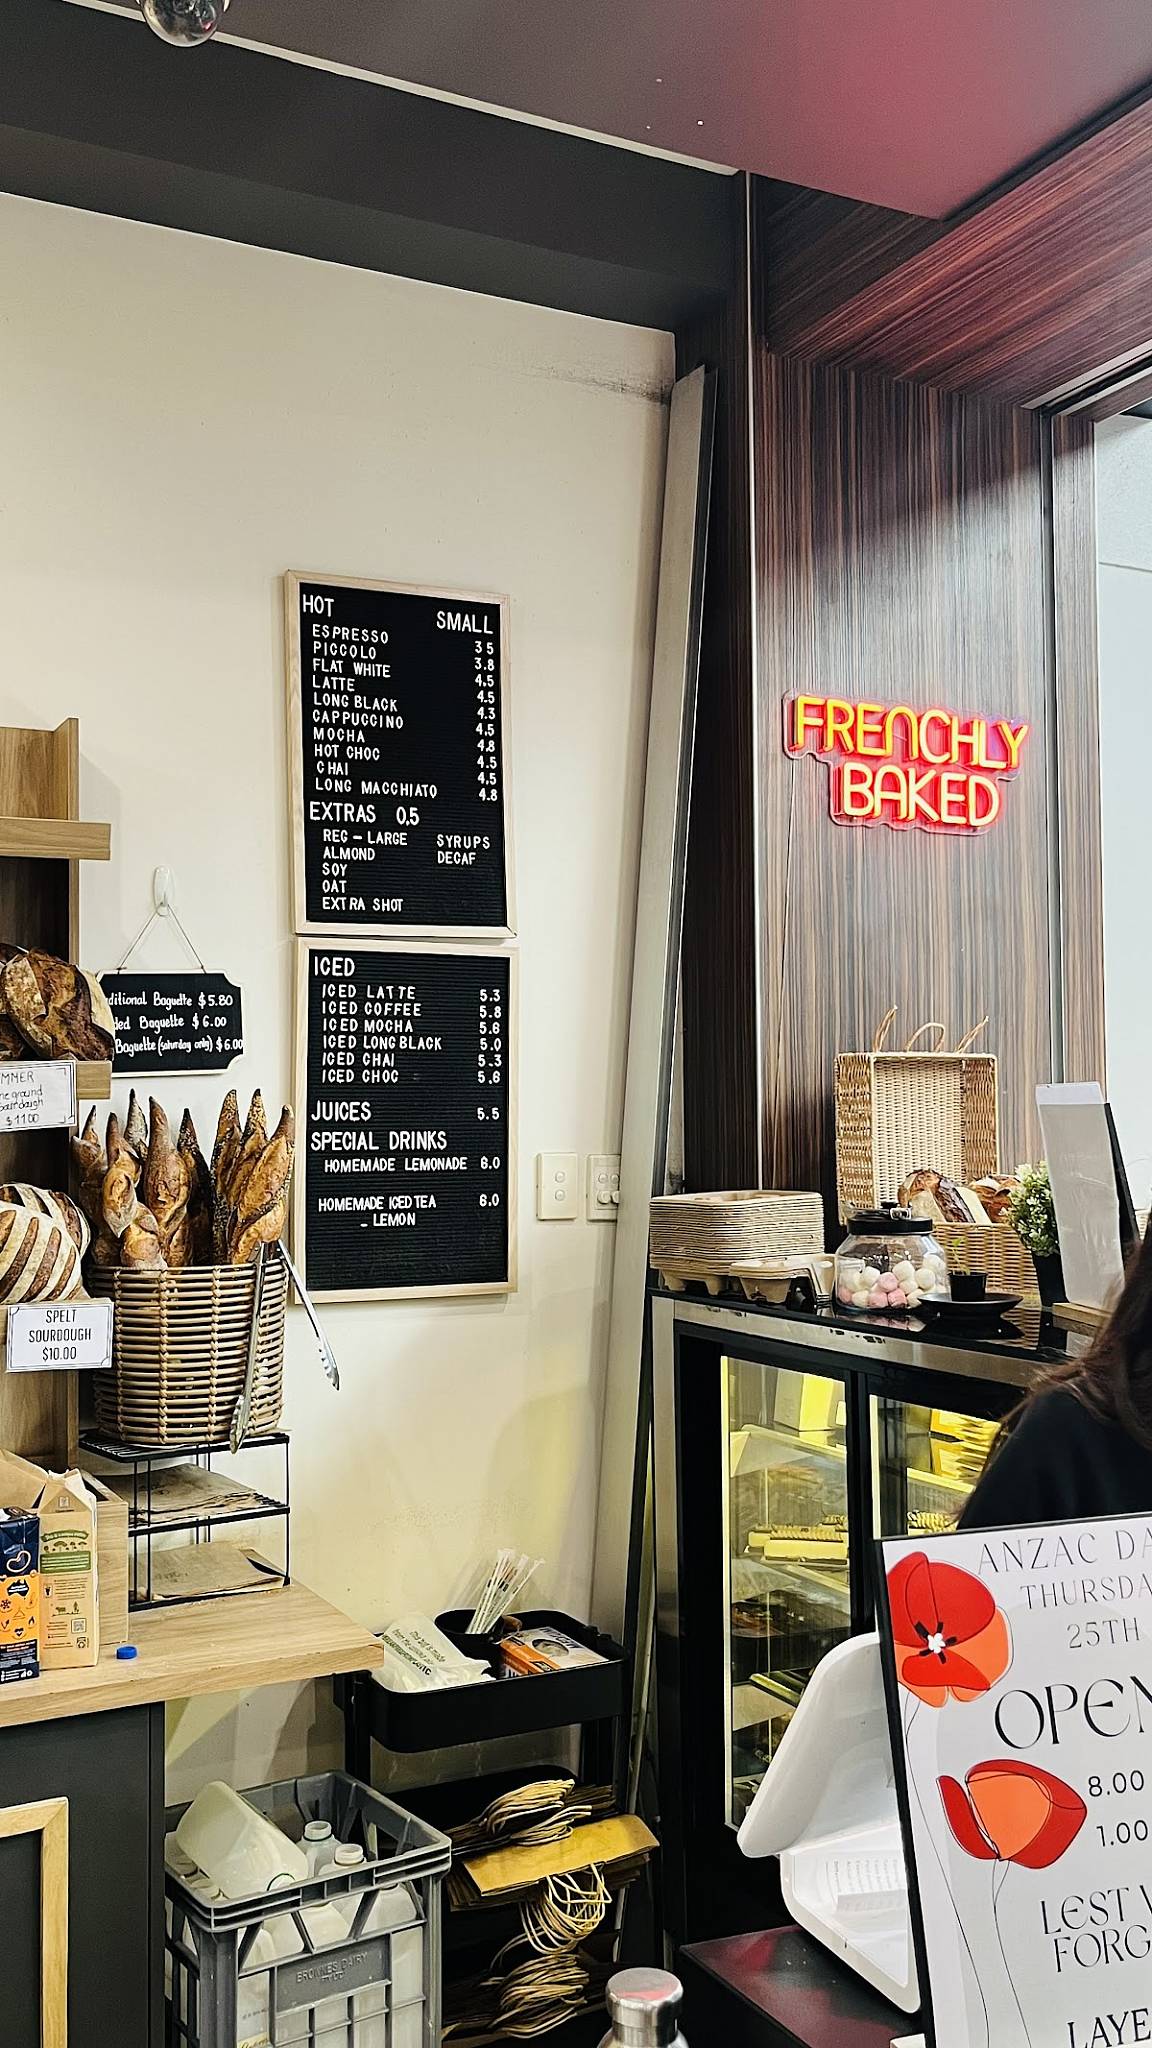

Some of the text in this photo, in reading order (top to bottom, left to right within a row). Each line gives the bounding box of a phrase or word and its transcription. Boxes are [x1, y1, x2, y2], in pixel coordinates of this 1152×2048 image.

[303, 594, 493, 634] HOT SMALL
[312, 624, 389, 644] ESPRESSO
[313, 641, 495, 671] PICCOLO 3.8
[312, 659, 494, 687] FLAT WHITE 4.5
[312, 675, 495, 704] LATTE 4.5
[313, 692, 495, 720] LONG BLACK 4.3
[312, 710, 495, 736] CAPPUCCINO 4.5
[796, 695, 1029, 769] FRENCHLY
[313, 727, 495, 753] MOCHA 4.8
[314, 744, 497, 769] HOT CHOC 4.5
[317, 761, 497, 785] CHAI 4.5
[315, 778, 498, 801] LONG MACCHIATO 4.8
[843, 762, 999, 827] BAKED
[309, 801, 376, 823] EXTRAS
[323, 829, 348, 843] REG
[368, 831, 408, 846] LARGE
[437, 834, 490, 849] SYRUPS
[323, 847, 476, 865] ALMOND DECAF
[322, 863, 348, 877] SOY
[322, 880, 347, 893] OAT
[322, 897, 403, 912] EXTRA SHOT
[314, 956, 355, 977] ICED
[106, 991, 147, 1006] ditional
[153, 992, 192, 1010] Baguette
[322, 984, 501, 1002] ICED LATTE 5.3
[322, 1001, 502, 1019] ICED COFFEE 5.8
[139, 1014, 185, 1034] Baguette
[323, 1018, 358, 1032] ICED
[364, 1019, 413, 1034] MOCHA
[115, 1036, 156, 1057] Baguette
[323, 1035, 502, 1051] ICED LONG BLACK 5.0
[322, 1052, 502, 1067] ICED CHAI 5.3
[0, 1071, 34, 1085] MMER
[322, 1069, 354, 1084] ICED
[362, 1069, 399, 1084] CHOC
[12, 1084, 42, 1102] ground
[311, 1100, 500, 1122] JUICES 5.5
[311, 1131, 448, 1151] SPECIAL DRINKS
[324, 1156, 500, 1173] HOMEMADE LEMONADE 6.0
[318, 1194, 500, 1212] HOMEMADE ICED TEA 6.0
[373, 1213, 416, 1227] LEMON
[46, 1310, 76, 1323] SPELT
[29, 1328, 91, 1343] SOURDOUGH
[43, 1347, 77, 1362] $10.00
[978, 1533, 1098, 1575] ANZAC
[1067, 1617, 1140, 1648] 25TH
[1088, 1770, 1144, 1797] 8.00
[1097, 1820, 1148, 1847] 1.00
[1041, 1887, 1129, 1935] LEST
